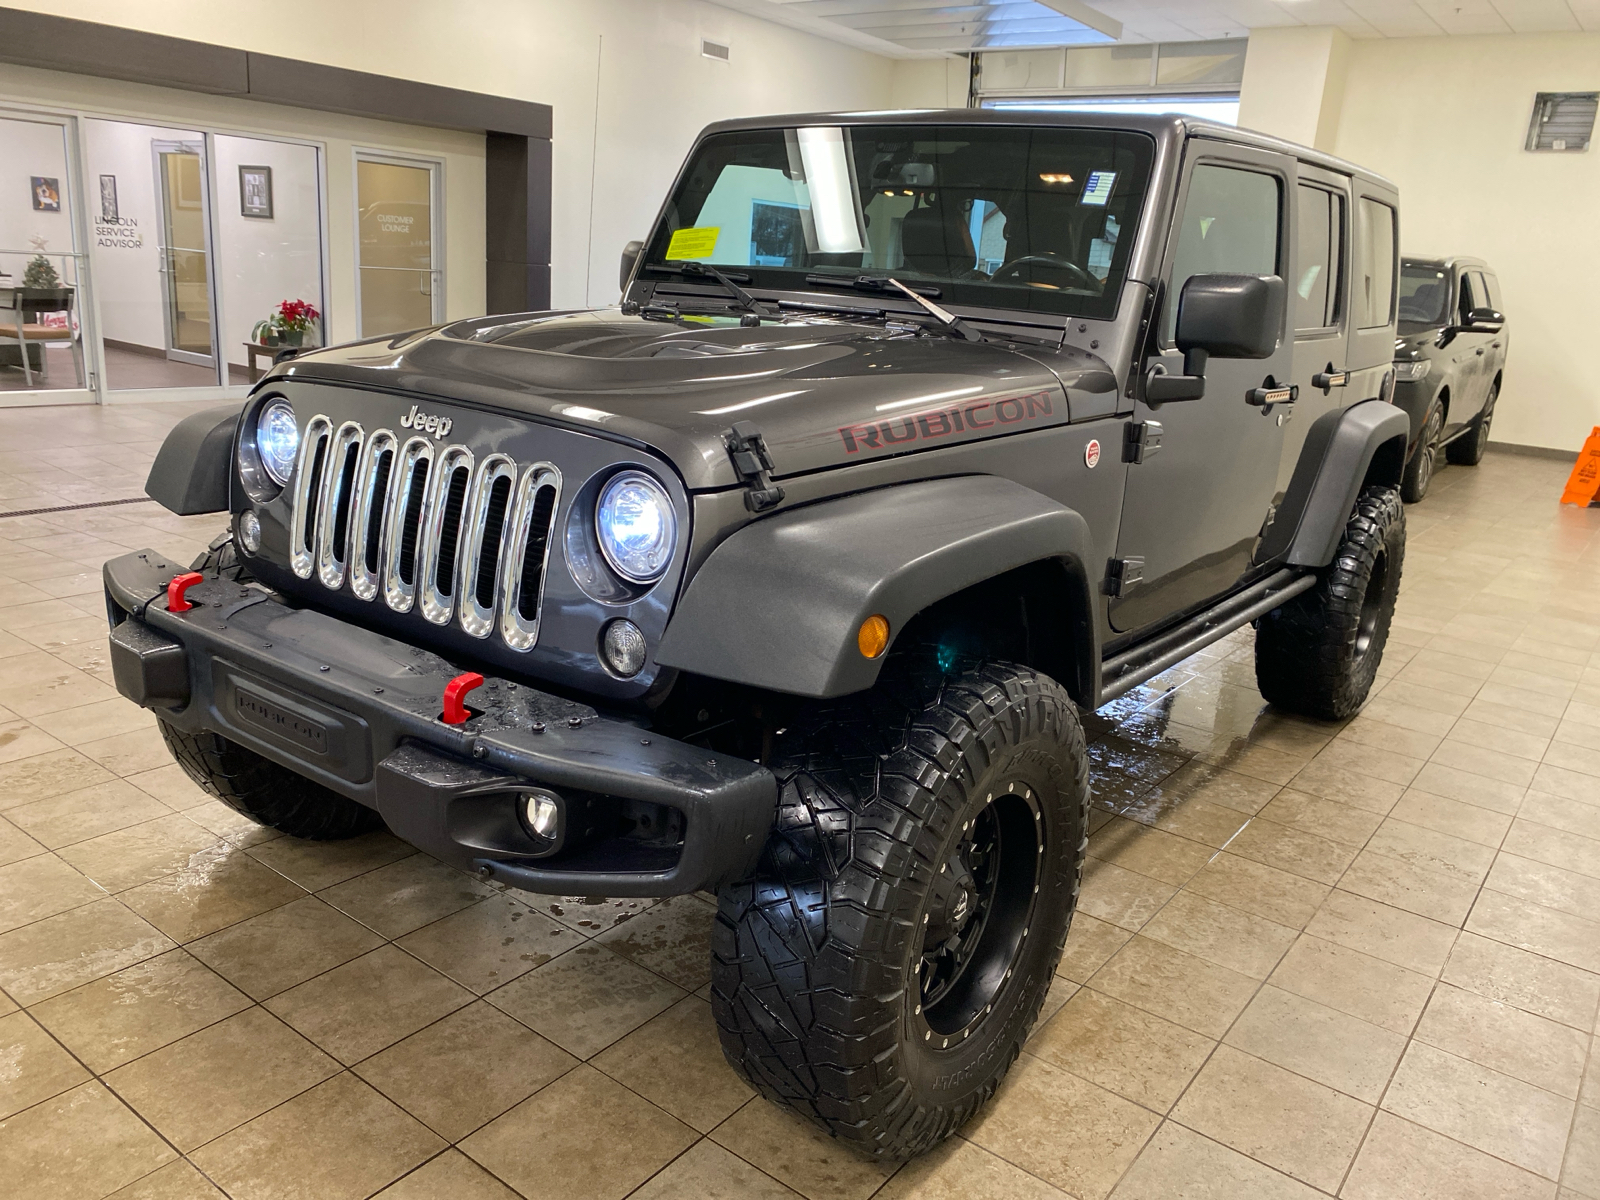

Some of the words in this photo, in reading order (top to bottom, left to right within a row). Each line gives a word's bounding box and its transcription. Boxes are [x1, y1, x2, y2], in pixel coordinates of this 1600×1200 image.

[94, 216, 138, 227] LINCOLN
[376, 214, 414, 225] CUSTOMER
[95, 226, 135, 238] SERVICE
[381, 223, 410, 234] LOUNGE
[97, 238, 143, 249] ADVISOR
[400, 405, 453, 440] Jeep
[838, 391, 1054, 454] RUBICON
